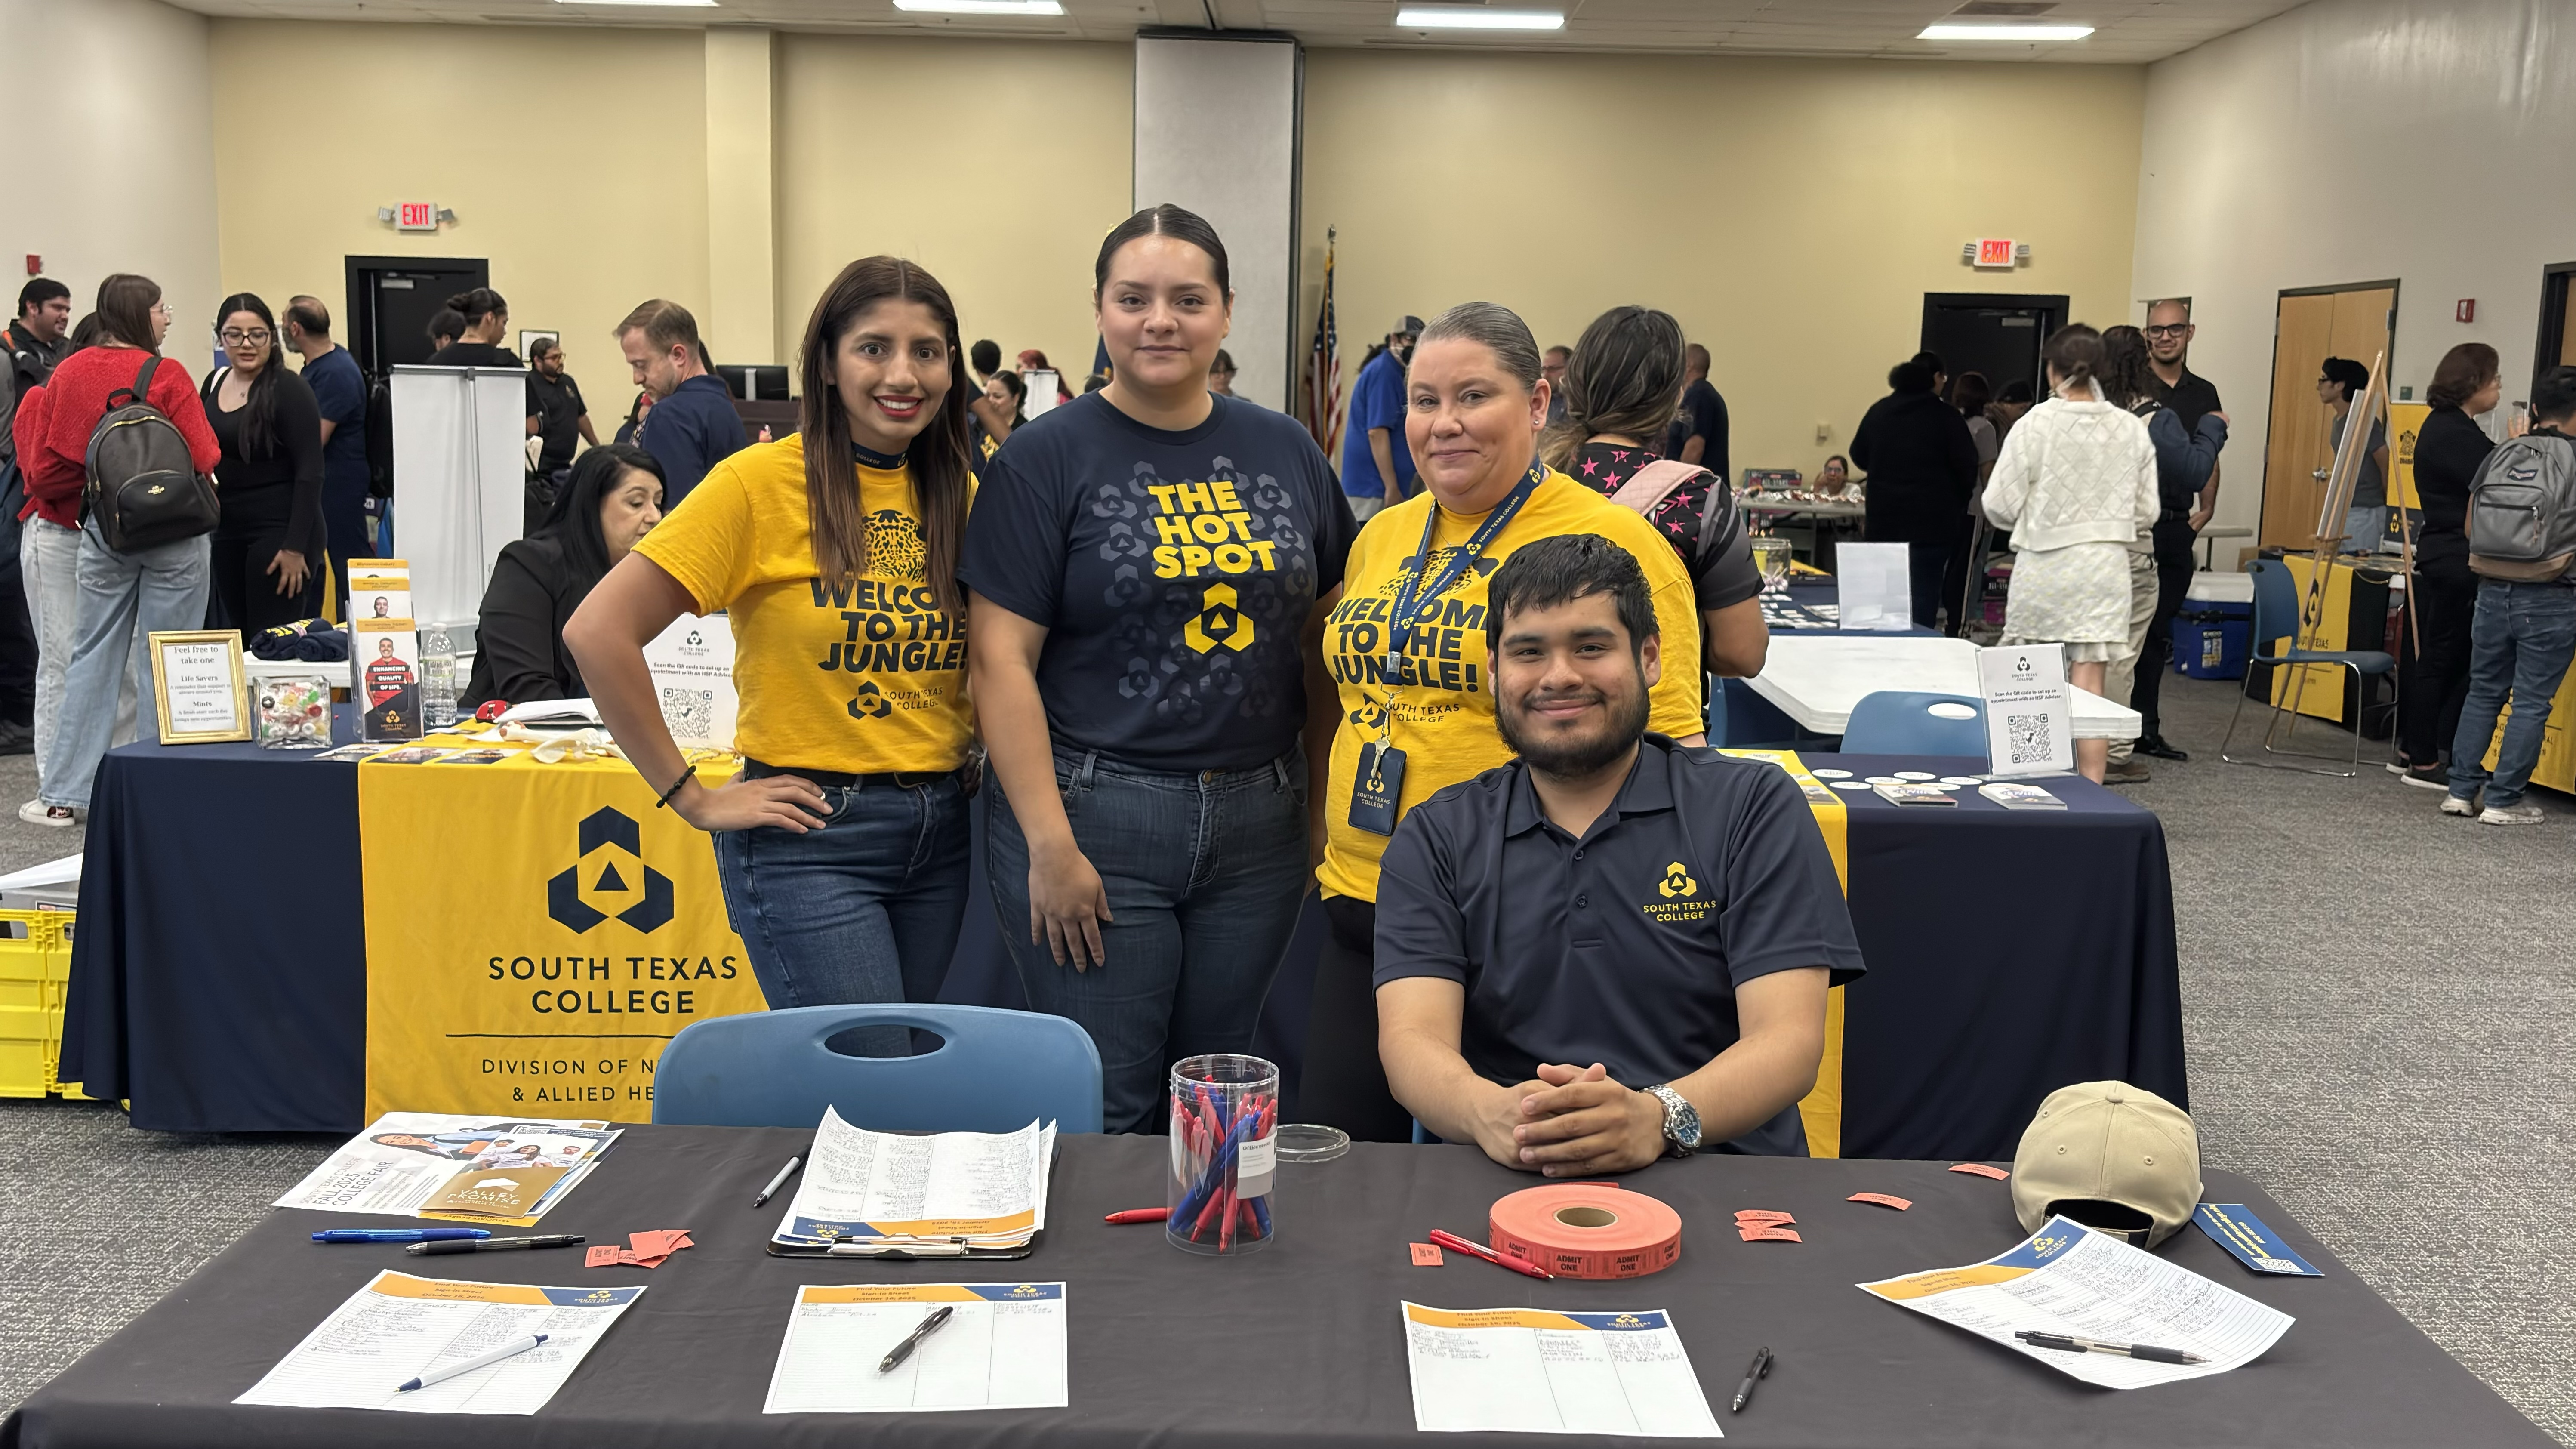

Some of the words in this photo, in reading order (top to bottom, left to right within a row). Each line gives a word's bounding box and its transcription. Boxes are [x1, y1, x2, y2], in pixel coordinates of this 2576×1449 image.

[402, 203, 429, 225] EXIT
[1981, 240, 2011, 263] EXIT
[1147, 481, 1242, 514] THE
[1154, 512, 1252, 544] HOT
[1479, 527, 1493, 543] SOUTH
[1491, 514, 1504, 529] TEXAS
[1503, 496, 1520, 515] COLLEGE
[1153, 540, 1276, 578] SPOT
[810, 578, 942, 614] WELCO
[1412, 601, 1425, 615] SOUTH
[1424, 588, 1437, 601] TEXAS
[1437, 570, 1454, 589] COLLEGE
[1330, 598, 1488, 630] WELOM
[1393, 607, 1402, 630] COLLEGE
[841, 611, 896, 642] TO
[900, 613, 967, 640] THE
[1338, 624, 1377, 654] TO
[818, 641, 968, 673] JUNGLE!
[1334, 654, 1478, 693] JUNGLE!
[1421, 704, 1460, 715] TEXAS
[1357, 791, 1374, 800] SOUTH
[1375, 796, 1390, 805] TEXAS
[1361, 799, 1384, 809] COLLEGE
[1643, 903, 1679, 913] SOUTH
[1682, 900, 1716, 911] TEXAS
[1657, 911, 1705, 922] COLLEGE
[489, 956, 610, 980] SOUTH
[626, 956, 737, 980] TEXAS
[532, 990, 694, 1013] COLLEGE
[482, 1059, 585, 1075] DIVISION
[598, 1059, 628, 1074] OF
[512, 1088, 524, 1102] &
[536, 1087, 616, 1101] ALLIED
[300, 1188, 321, 1204] SOUTH
[320, 1176, 339, 1189] TEXAS
[333, 1156, 363, 1176] COLLEGE
[312, 1189, 342, 1205] FALL
[333, 1173, 360, 1191] 2025
[332, 1176, 374, 1206] COLLEGE
[367, 1161, 394, 1176] FAIR
[447, 1194, 520, 1205] PROMISE
[461, 1190, 518, 1199] VALLEY
[1509, 1242, 1526, 1254] ADMIT
[1665, 1252, 1674, 1261] ONE
[2036, 1248, 2052, 1259] SOUTH
[2053, 1235, 2068, 1247] TEXAS
[1556, 1254, 1582, 1264] ADMIT
[1616, 1254, 1639, 1264] ADMIT
